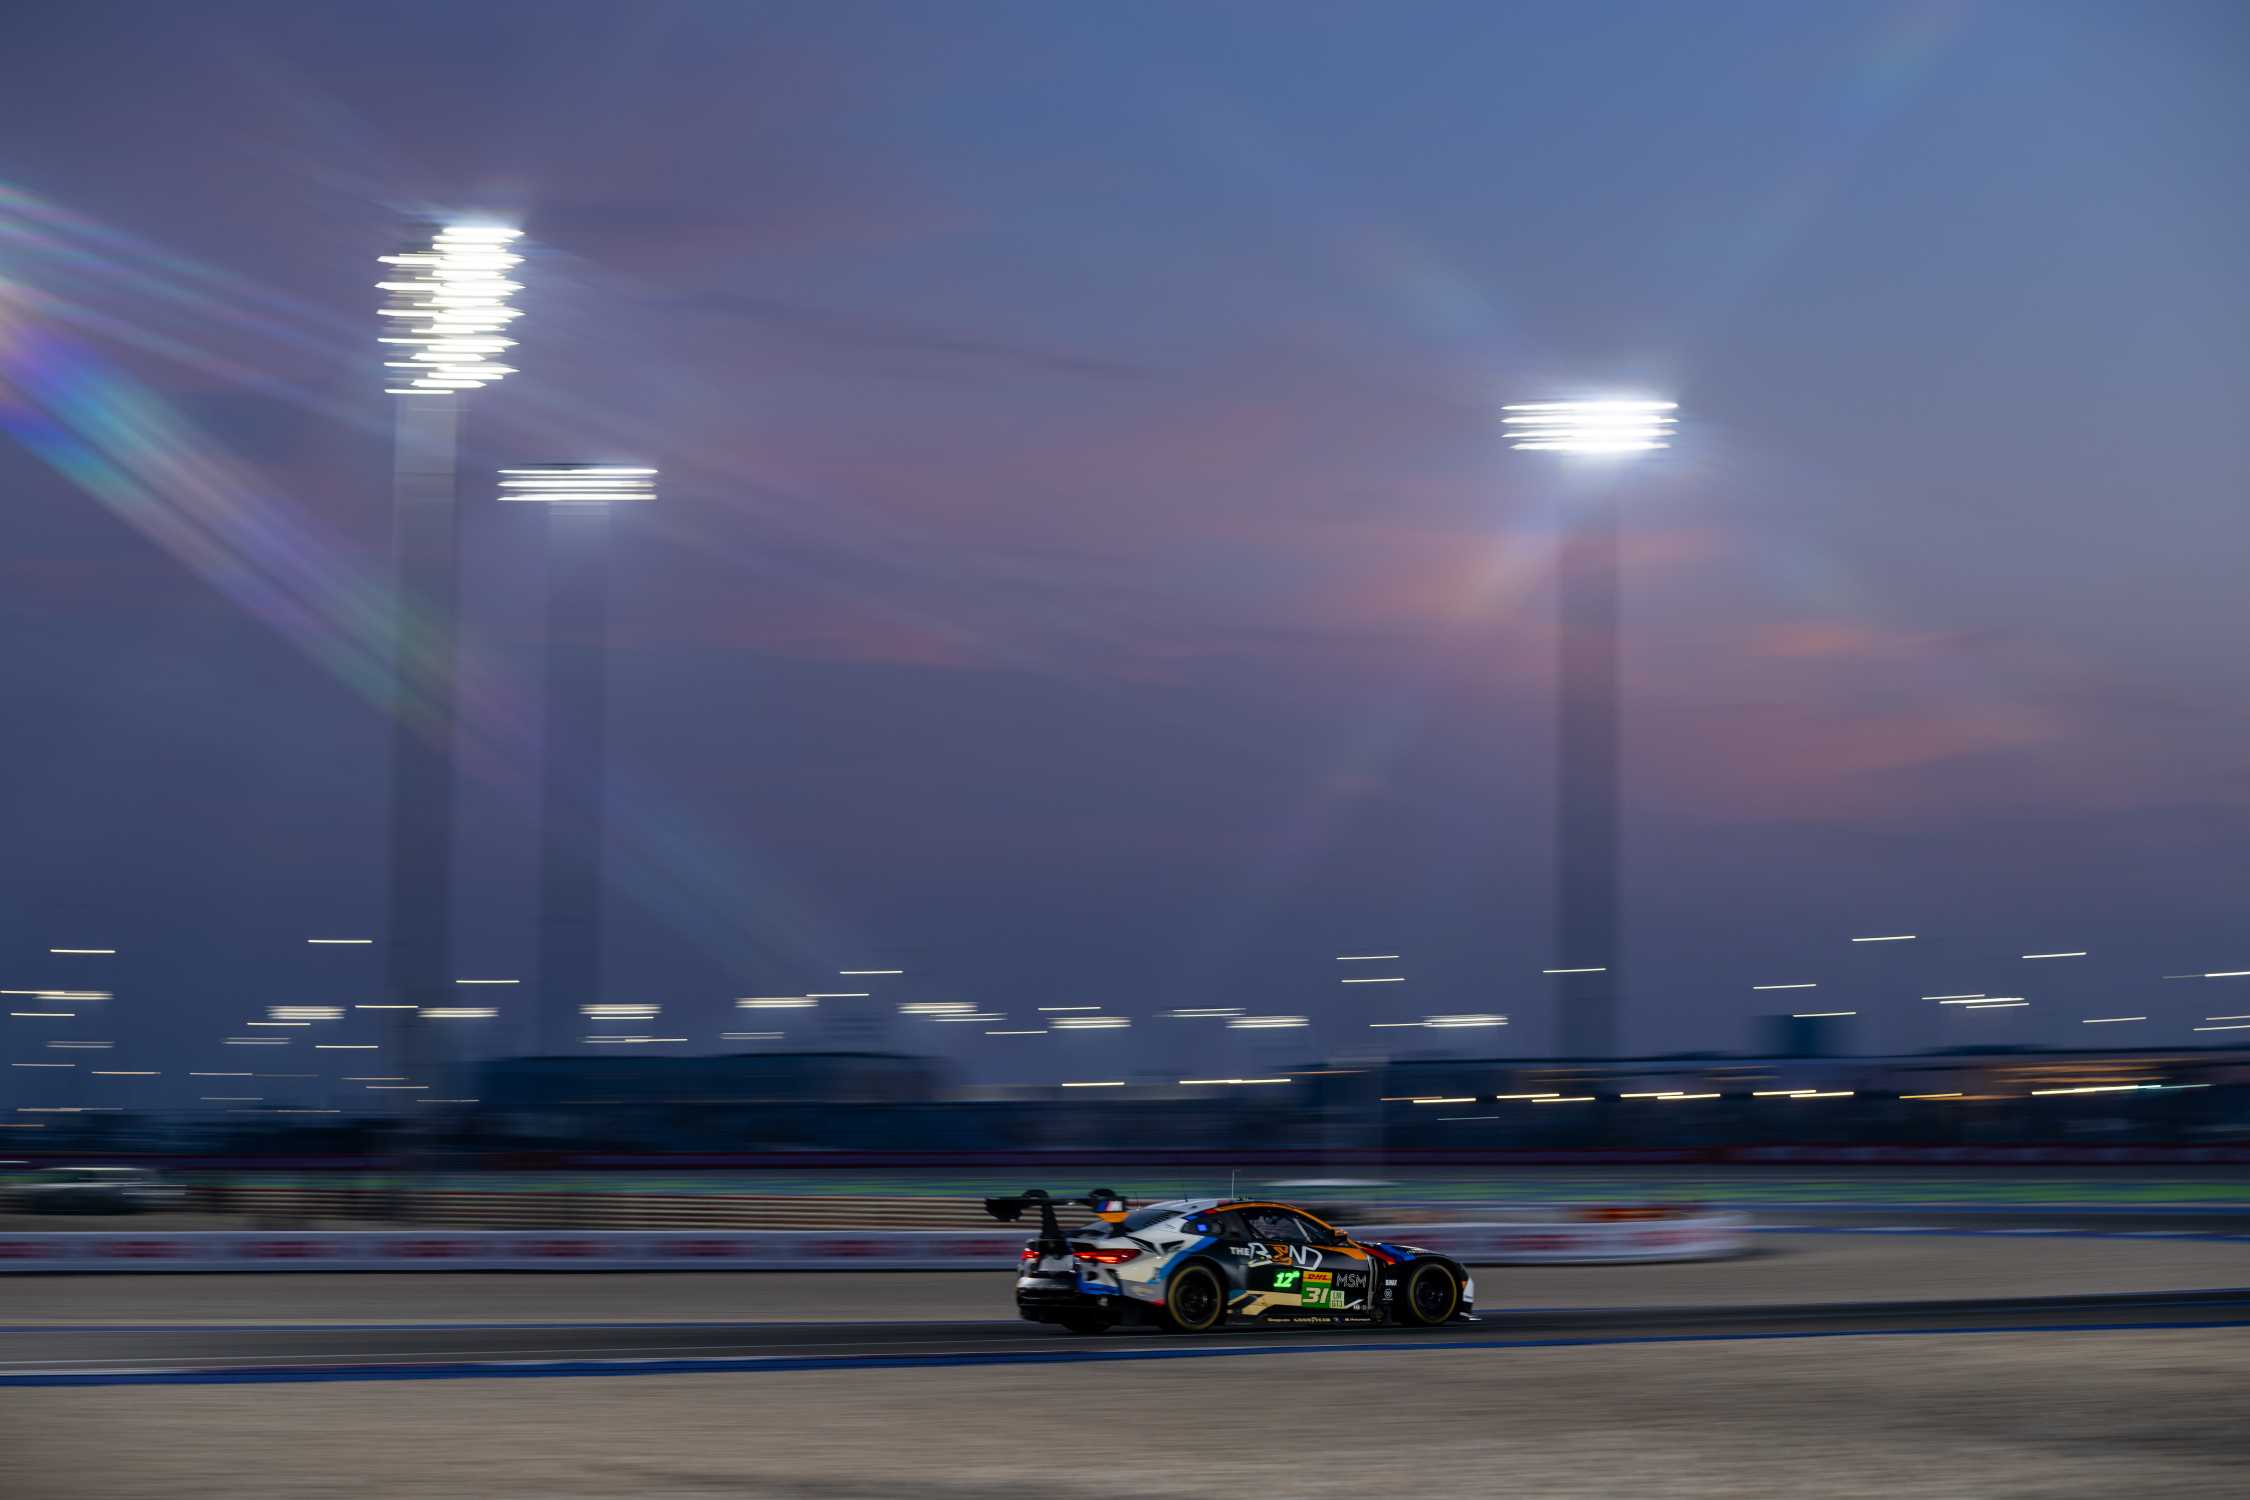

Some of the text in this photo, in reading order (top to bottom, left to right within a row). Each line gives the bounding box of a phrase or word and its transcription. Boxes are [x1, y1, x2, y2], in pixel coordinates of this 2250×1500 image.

[1229, 1242, 1323, 1271] THE BEND
[1307, 1273, 1329, 1281] DHL
[1336, 1273, 1367, 1288] MSM
[1302, 1287, 1329, 1304] 31
